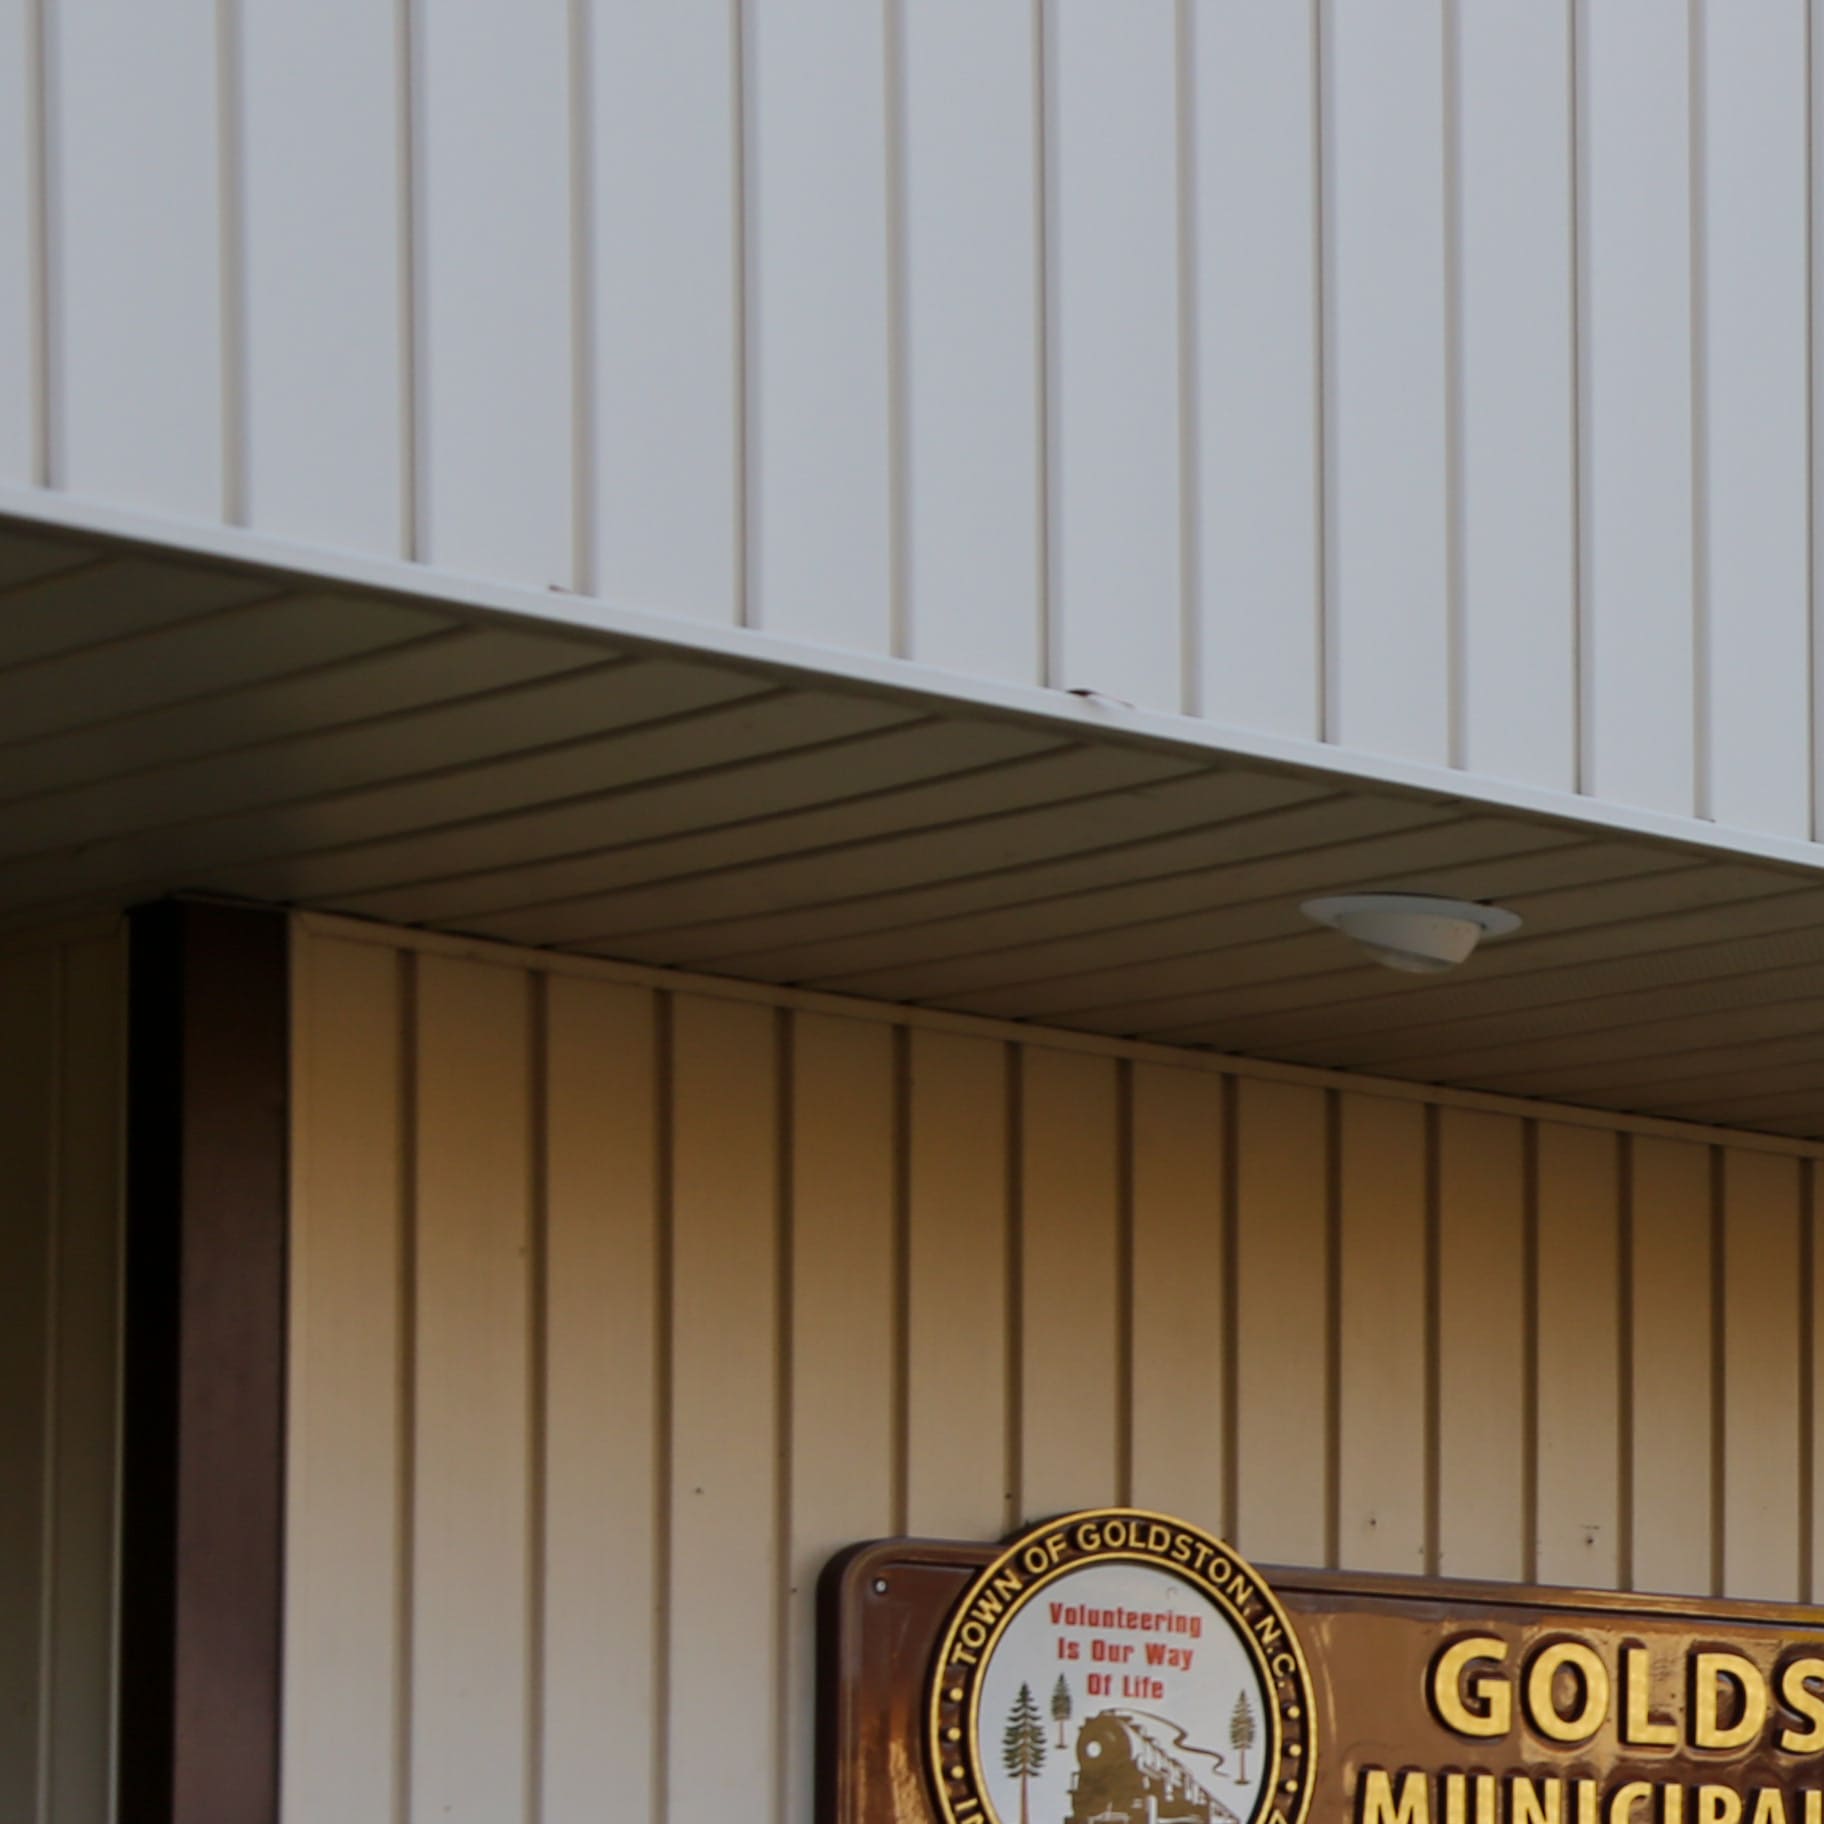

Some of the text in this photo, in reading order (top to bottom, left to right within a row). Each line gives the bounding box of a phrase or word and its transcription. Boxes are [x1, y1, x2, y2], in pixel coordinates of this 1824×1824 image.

[951, 1520, 1296, 1688] TOWN OF GOLDSTON, N.C.
[1049, 1602, 1203, 1638] Volunteering
[1057, 1637, 1194, 1672] Is Our Way
[1087, 1672, 1165, 1700] Of Life
